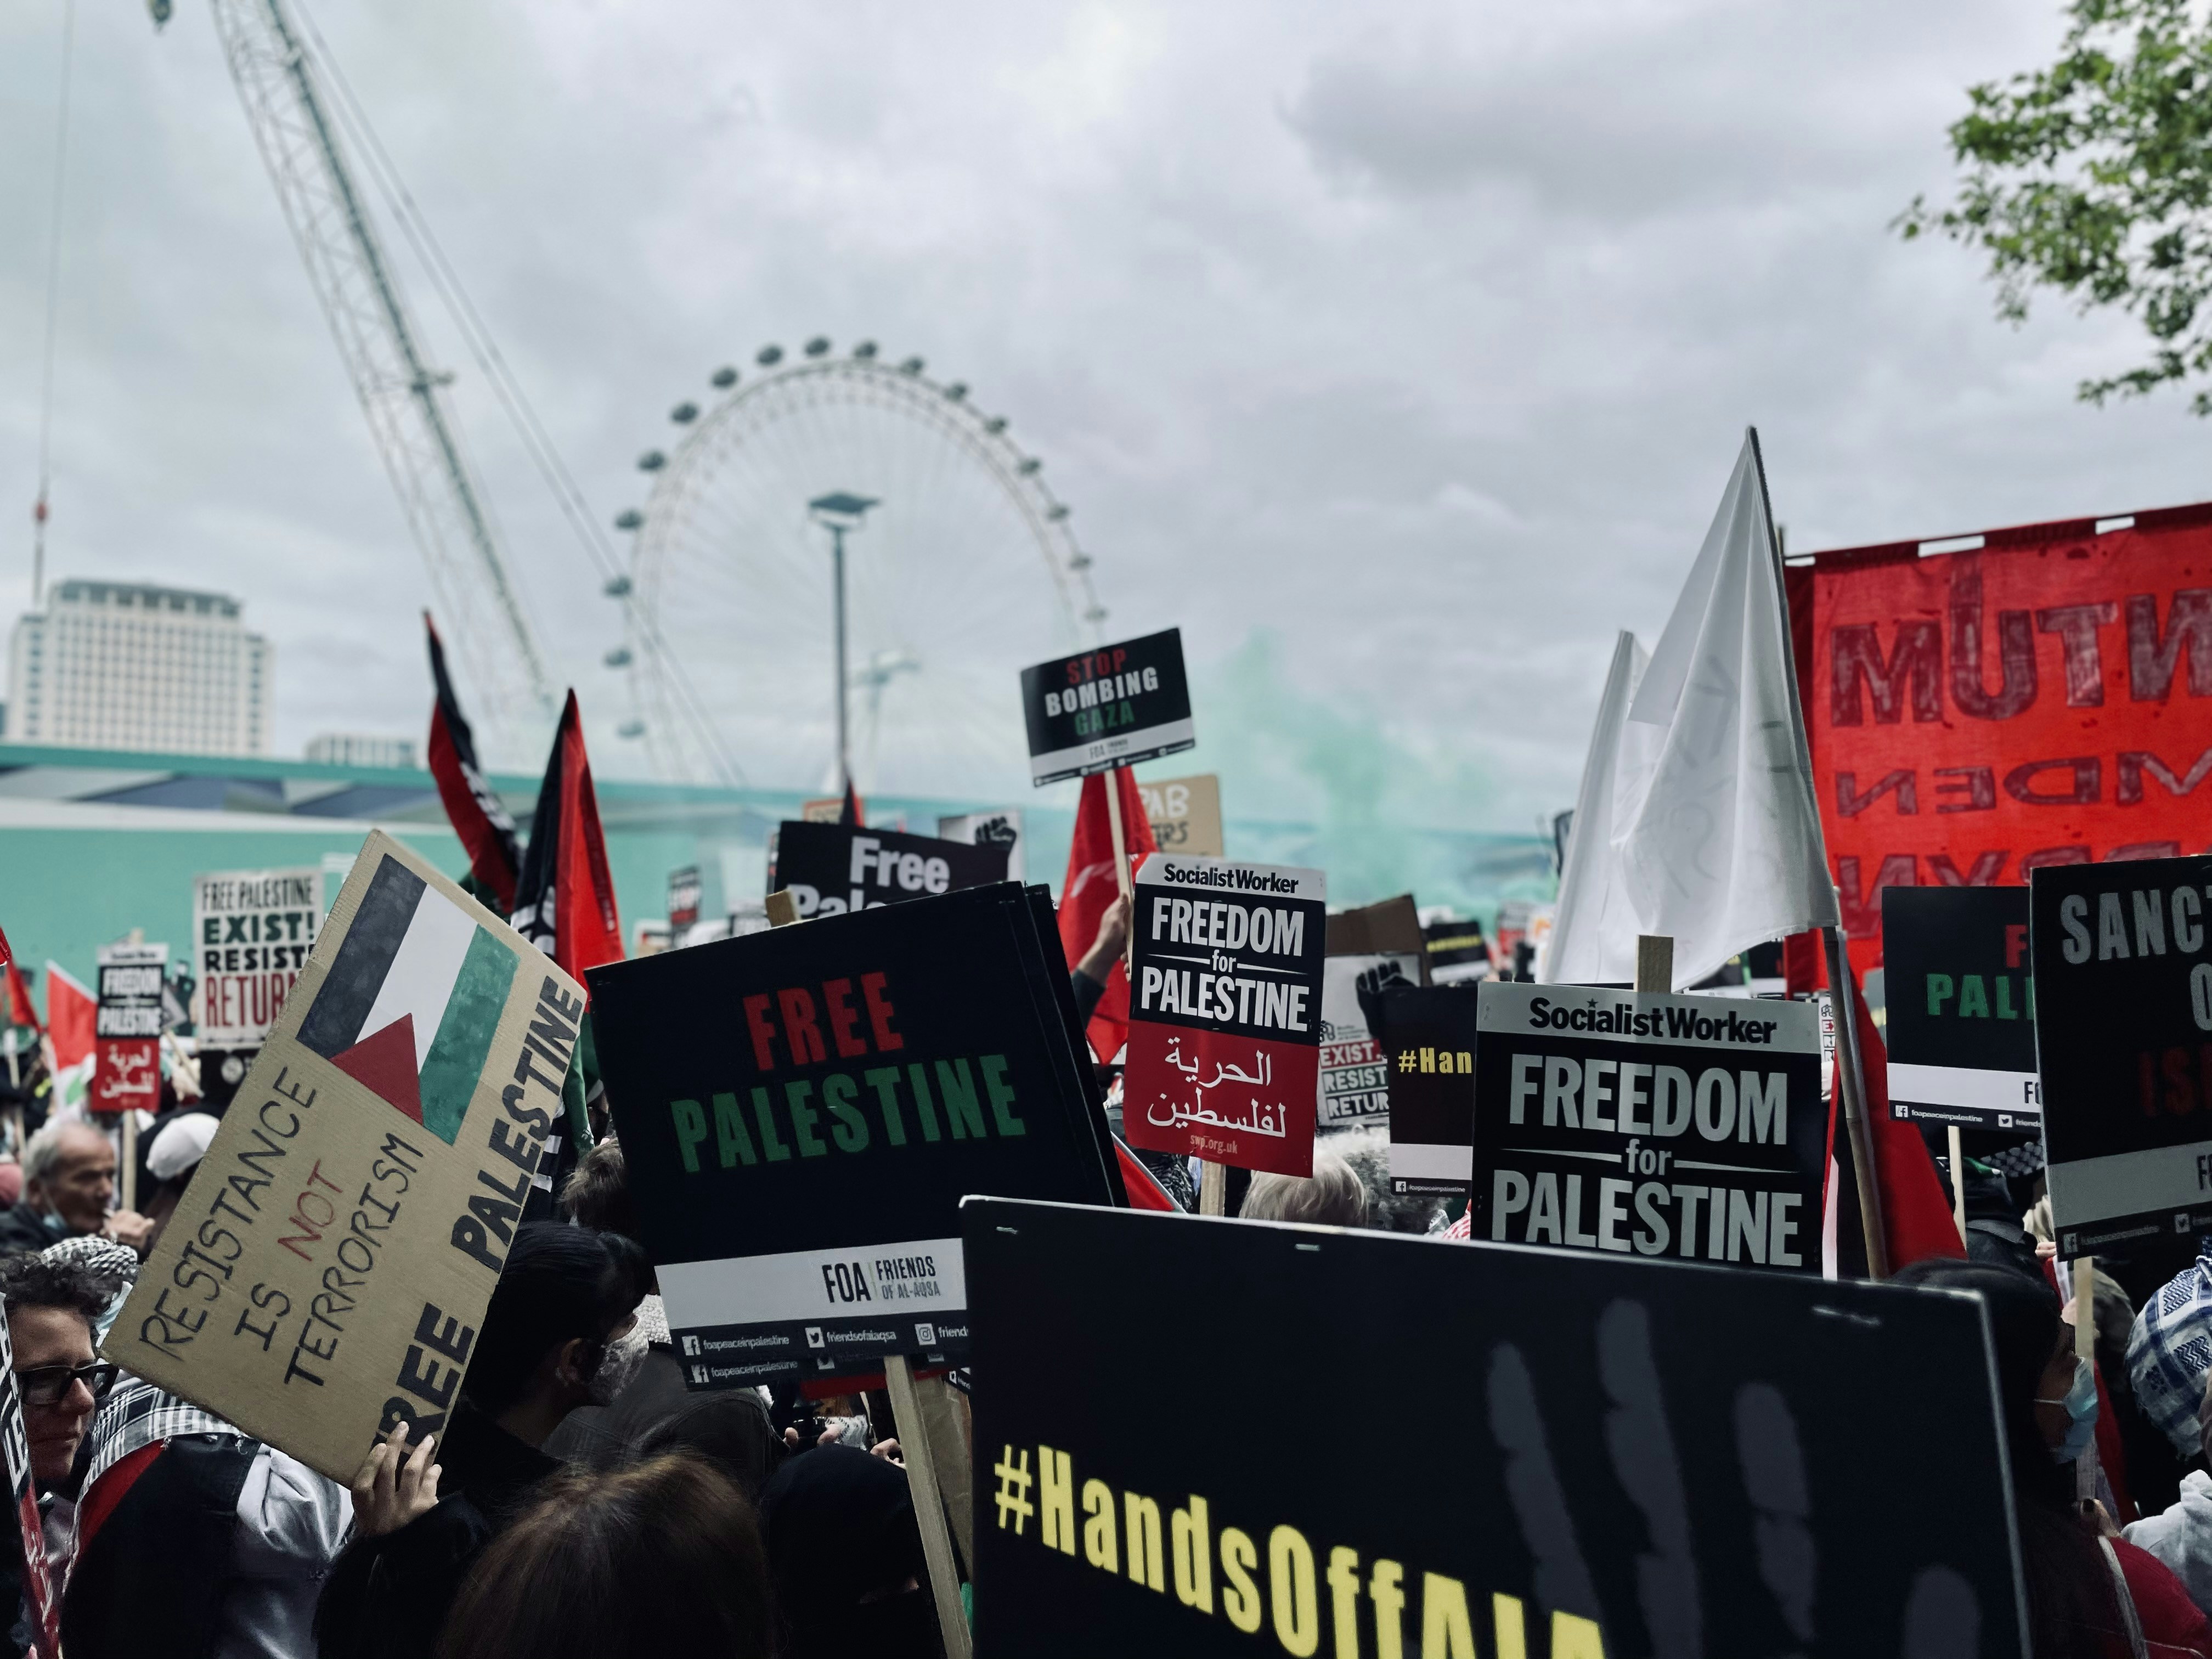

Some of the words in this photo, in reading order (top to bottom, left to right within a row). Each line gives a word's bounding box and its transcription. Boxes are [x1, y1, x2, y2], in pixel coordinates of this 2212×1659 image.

[1066, 648, 1127, 685] STOP
[1045, 667, 1159, 718] BOMBING
[1074, 701, 1135, 737] GAZA
[849, 836, 950, 894] Free
[1164, 864, 1234, 888] Socialist
[1235, 868, 1299, 894] Worker
[203, 881, 235, 911] FREE
[239, 878, 312, 910] PALESTINE
[204, 912, 315, 945] EXIST!
[1151, 897, 1304, 956] FREEDOM
[2060, 885, 2212, 964] SANC
[205, 944, 316, 971] RESIST
[1212, 949, 1236, 973] for
[206, 973, 296, 1027] RETUR
[743, 971, 904, 1071] FREE
[1141, 966, 1310, 1032] PALESTINE
[1529, 997, 1663, 1038] Socialist
[1666, 1007, 1777, 1043] Worker
[1164, 1036, 1272, 1088] الحرية
[1319, 1042, 1381, 1067] EXIST.
[450, 975, 583, 1274] PALESTINE
[669, 1054, 1025, 1174] PALESTINE
[1147, 1087, 1286, 1138] لفلسطين
[1509, 1053, 1787, 1145] FREEDOM
[1189, 1134, 1238, 1154] swp.org.uk
[1626, 1138, 1672, 1175] for
[139, 1066, 317, 1361] RESISTANCE
[278, 1159, 342, 1261] NOT
[1491, 1170, 1802, 1266] PALESTINE
[284, 1133, 424, 1386] TERRORISM
[822, 1262, 871, 1303] FOA
[876, 1256, 936, 1280] FRIENDS
[882, 1284, 894, 1300] OF
[897, 1280, 941, 1299] AL-AQSA
[234, 1283, 291, 1351] IS
[703, 1335, 789, 1351] foapeaceinpalestine
